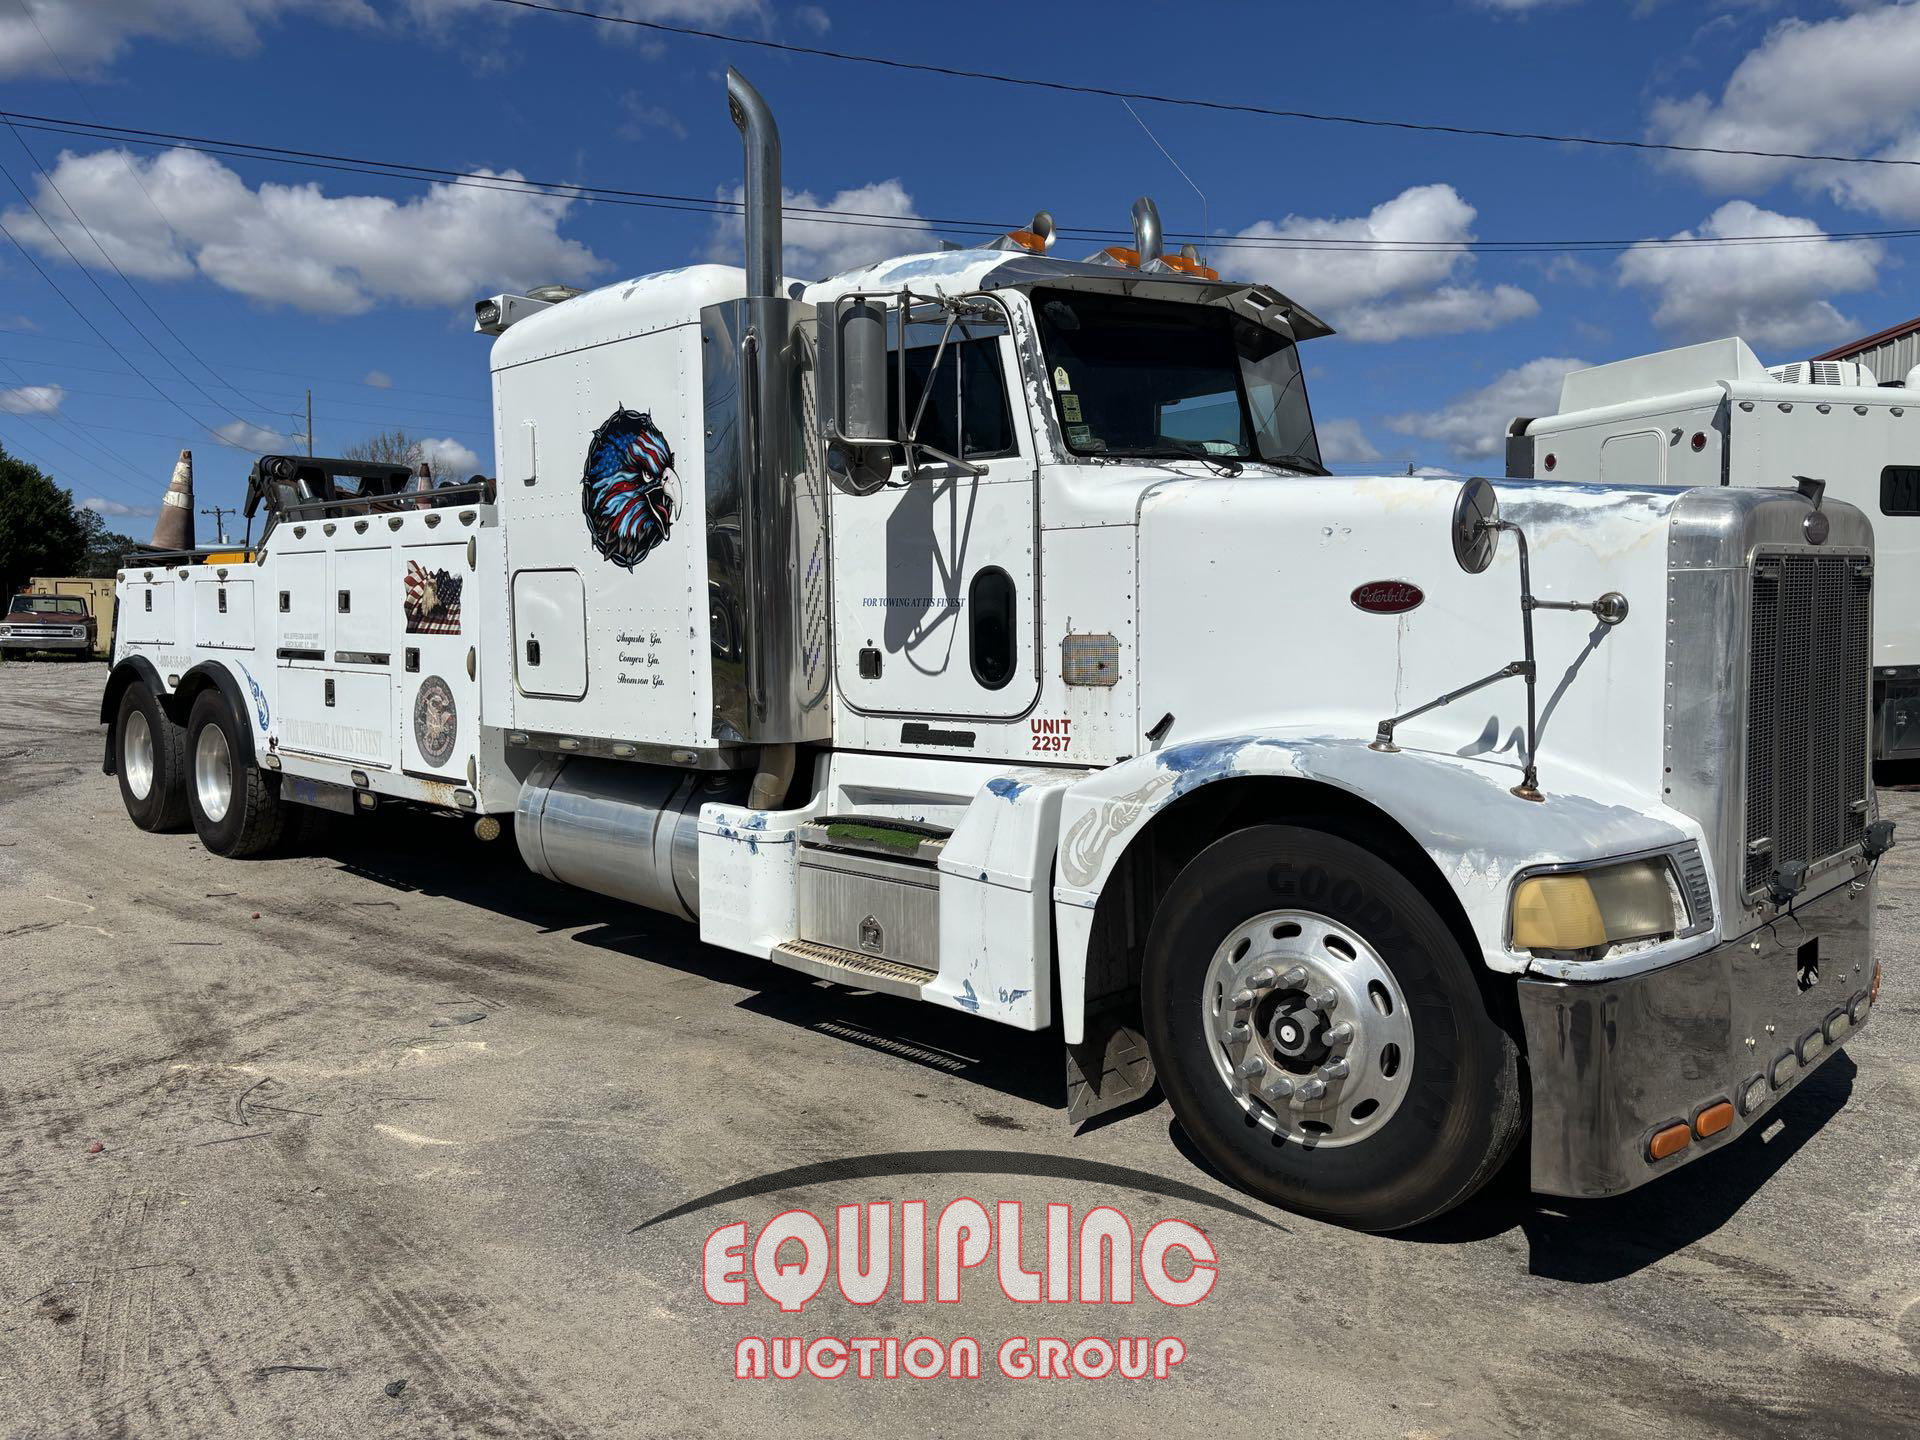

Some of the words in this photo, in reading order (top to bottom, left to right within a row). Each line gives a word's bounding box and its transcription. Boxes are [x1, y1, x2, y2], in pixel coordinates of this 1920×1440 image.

[862, 597, 878, 607] FOR
[879, 597, 911, 607] TOWING
[911, 598, 922, 607] AT
[922, 598, 936, 607] ITS
[936, 598, 967, 608] FINEST
[1358, 587, 1417, 605] Peterbilt
[616, 632, 645, 645] Augusta
[650, 633, 662, 647] Ga.
[619, 651, 644, 666] Conyers
[647, 653, 660, 667] Ga.
[617, 672, 649, 685] Thomson
[652, 674, 665, 689] Ga.
[1030, 719, 1072, 734] UNIT
[1032, 736, 1071, 751] 2297
